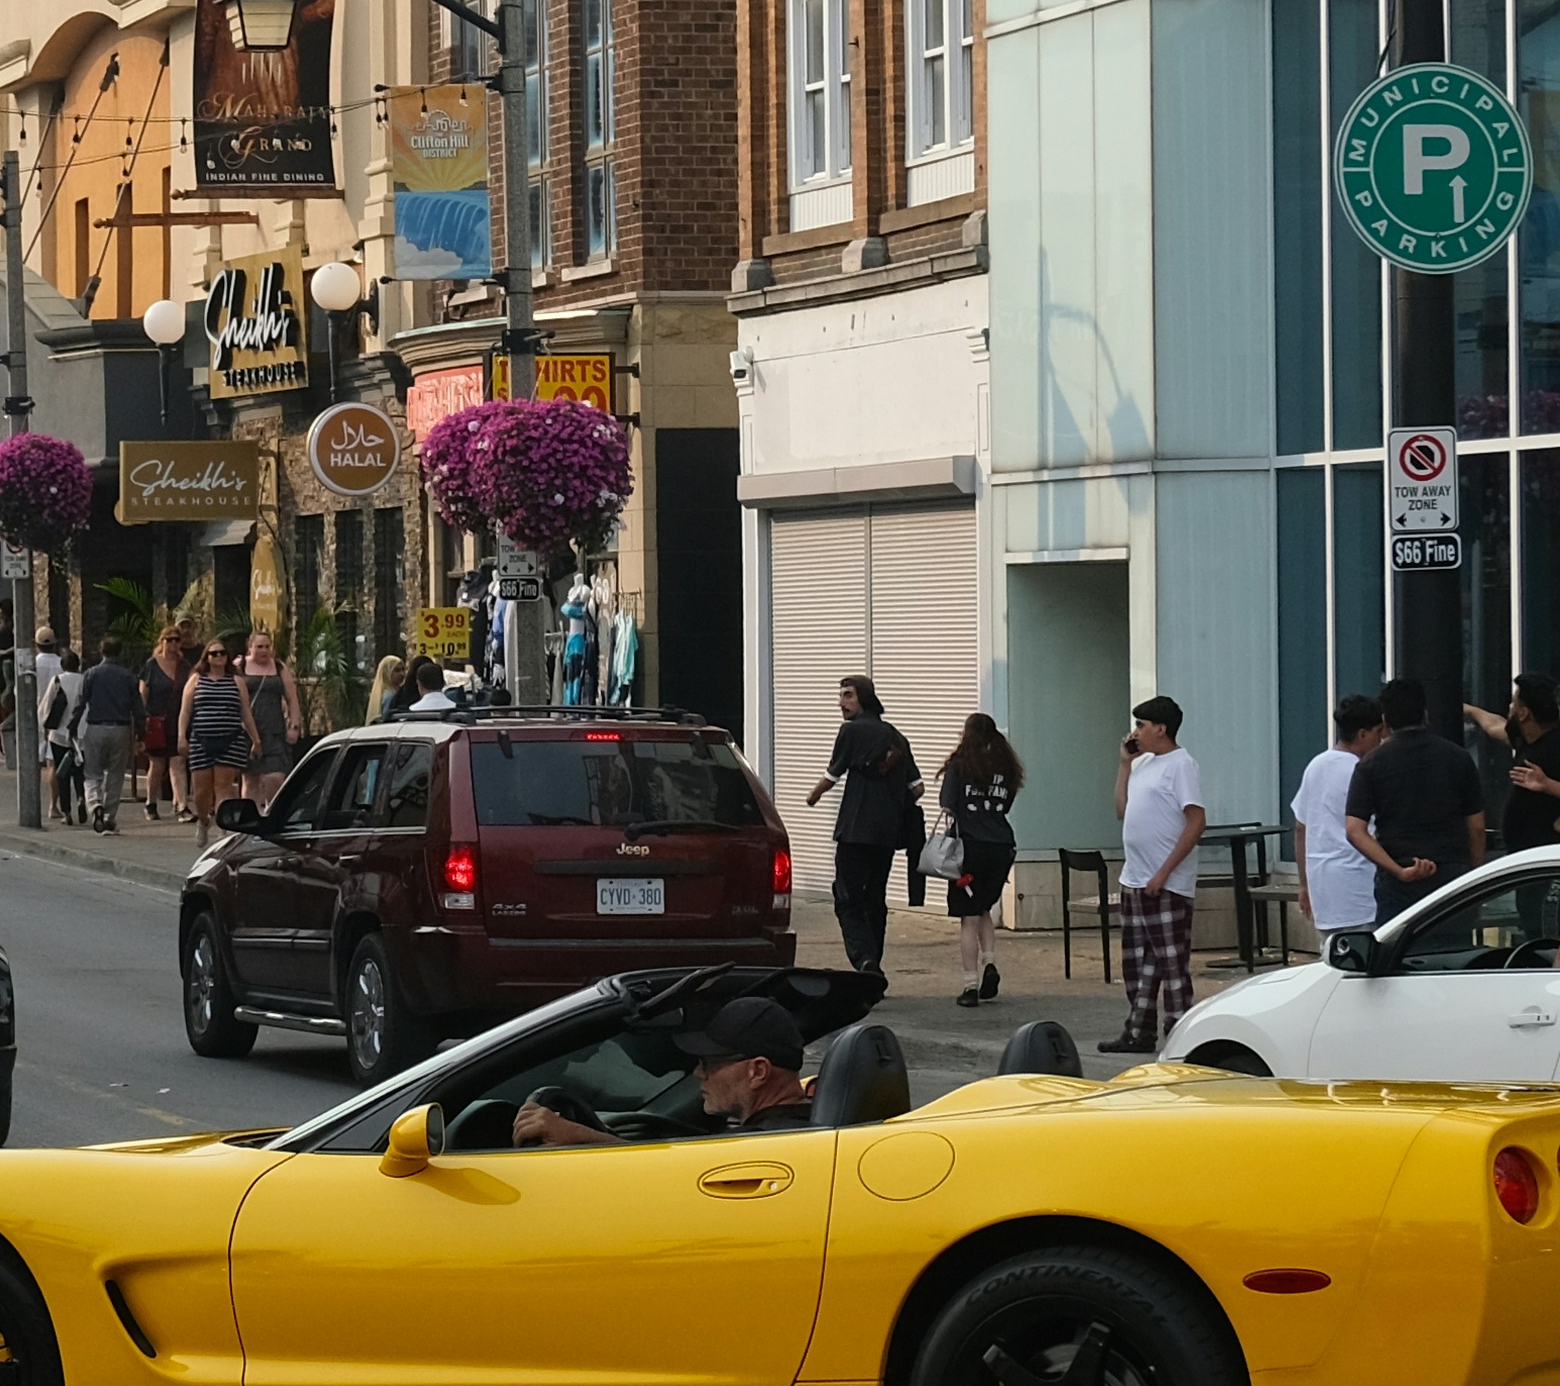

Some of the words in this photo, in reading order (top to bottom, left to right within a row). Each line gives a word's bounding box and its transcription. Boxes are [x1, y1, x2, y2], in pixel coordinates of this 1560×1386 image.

[1348, 76, 1518, 162] MUNICIPAL
[410, 135, 444, 153] Clifton
[447, 134, 469, 151] Hill
[1403, 124, 1470, 195] P
[206, 173, 246, 181] INDIAN
[252, 173, 278, 181] FINE
[284, 173, 324, 181] DINING
[1355, 190, 1514, 258] PARKING
[331, 420, 384, 450] حلال
[330, 453, 386, 468] HALAL
[130, 460, 247, 497] Sheikh's
[131, 496, 251, 507] STEAKHOUSE
[1395, 486, 1418, 498] TOW
[1422, 486, 1451, 497] AWAY
[1408, 499, 1437, 510] ZONE
[1395, 540, 1421, 565] $66
[1426, 539, 1455, 562] Fine
[616, 842, 650, 857] Jeep
[600, 888, 630, 906] CYVD
[639, 887, 661, 905] 380
